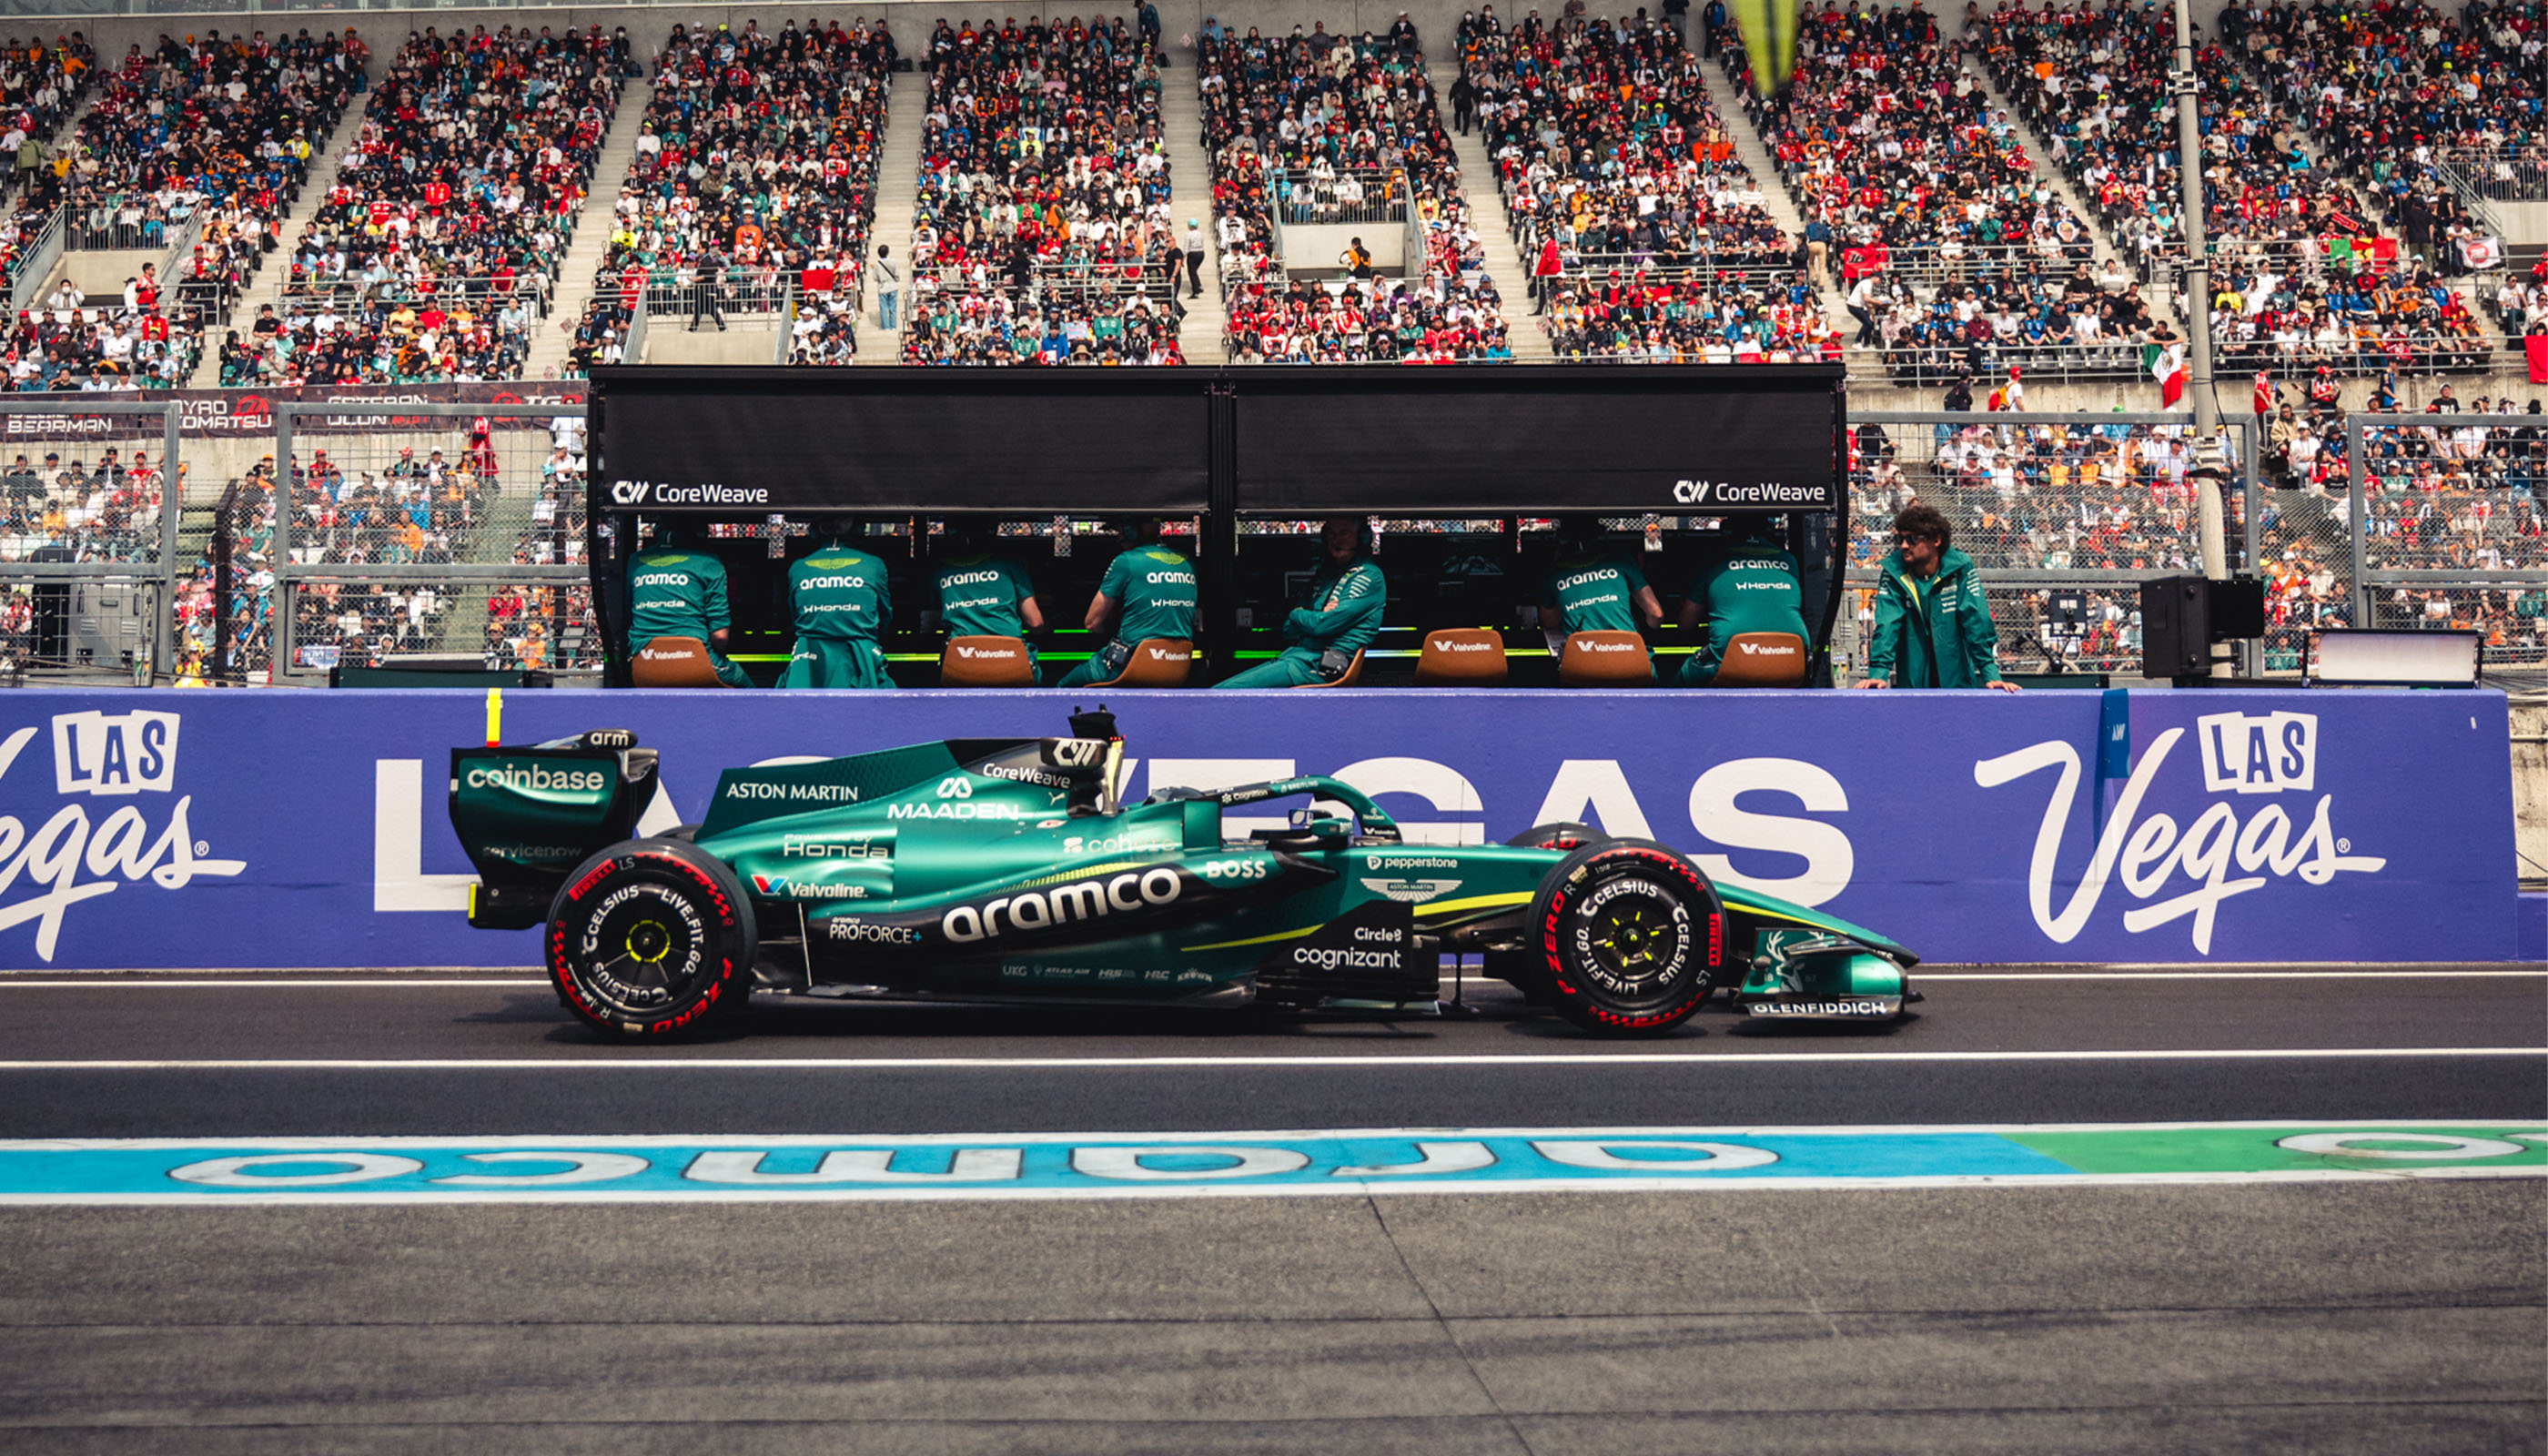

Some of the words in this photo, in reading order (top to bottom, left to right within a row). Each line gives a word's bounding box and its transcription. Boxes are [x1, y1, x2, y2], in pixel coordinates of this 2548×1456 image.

[7, 418, 112, 433] BEARMAN
[179, 414, 272, 429] OMATSU
[655, 483, 768, 502] CoreWeave
[1715, 482, 1825, 501] CoreWeave
[1728, 560, 1789, 571] aramco
[634, 573, 688, 587] aramco
[800, 576, 864, 590] aramco
[940, 571, 998, 589] aramco
[1557, 568, 1618, 591] aramco
[1748, 581, 1791, 590] Honda
[642, 600, 685, 609] Honda
[814, 603, 860, 612] Honda
[956, 597, 998, 608] Honda
[1575, 594, 1618, 608] Honda
[975, 650, 1016, 659] Valvoline
[1452, 642, 1492, 652] Valvoline
[1594, 642, 1635, 652] Valvoline
[1758, 645, 1795, 655] Valvoline
[653, 651, 694, 660] Valvoline
[591, 732, 629, 746] arm
[66, 719, 167, 784] LAS
[2211, 720, 2305, 783] LAS
[468, 763, 604, 790] coinbase
[983, 763, 1071, 789] CoreWeave
[727, 783, 786, 799] ASTON
[790, 784, 858, 801] MARTIN
[887, 803, 1019, 820] MAADEN
[482, 842, 582, 857] servicenow
[784, 843, 888, 858] Honda
[1206, 860, 1267, 878] BOSS
[1385, 856, 1458, 869] pepperstone
[788, 882, 866, 898] Valvoline
[942, 867, 1181, 943] aramco
[1544, 890, 1564, 972] ZERO
[1294, 946, 1401, 970] cognizant
[1003, 966, 1027, 976] UKG
[1145, 970, 1170, 979] HRC
[652, 981, 722, 1034] ZERO
[1754, 1002, 1886, 1014] GLENFIDDICH
[167, 1140, 1781, 1186] aramco
